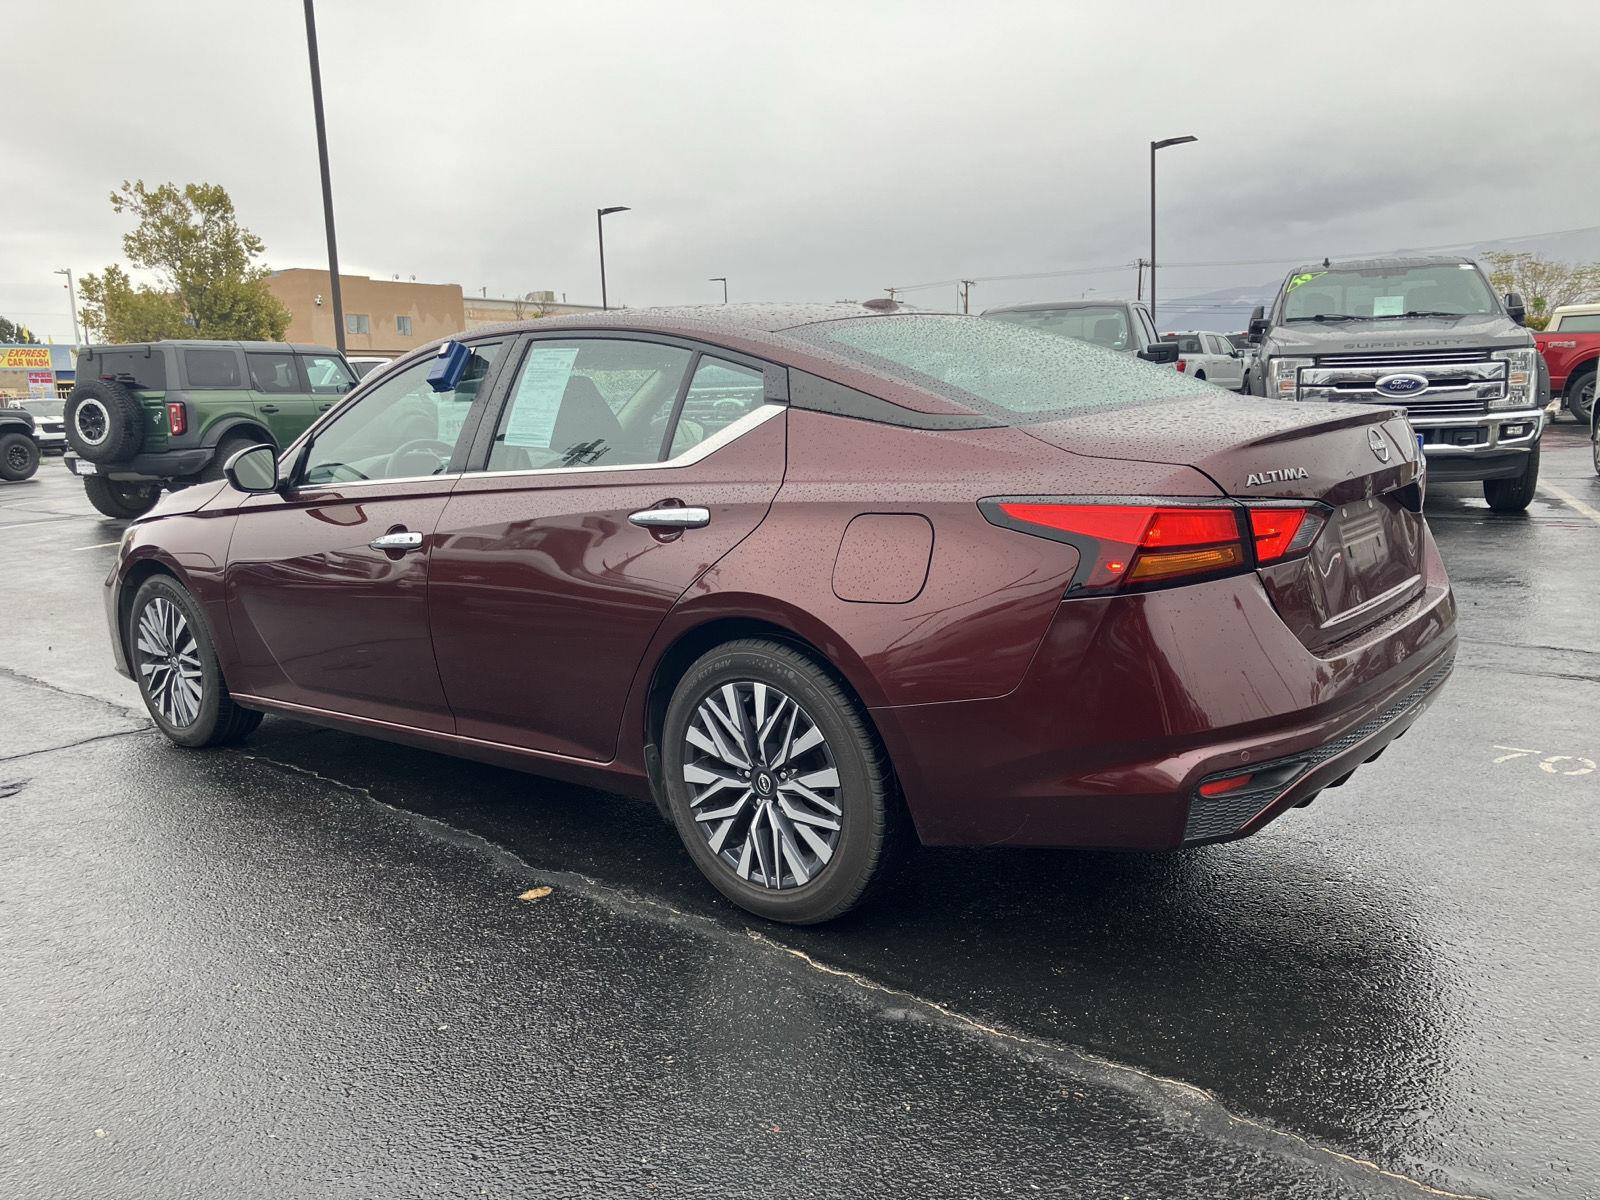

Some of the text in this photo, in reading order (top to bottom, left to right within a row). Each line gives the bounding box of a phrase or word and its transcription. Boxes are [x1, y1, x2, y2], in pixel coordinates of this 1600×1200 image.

[1343, 339, 1464, 350] SUPER DUTY
[8, 349, 49, 358] EXPRESS
[7, 358, 50, 367] CAR WASH
[1389, 379, 1416, 390] Ford
[1246, 467, 1309, 487] ALTIMA
